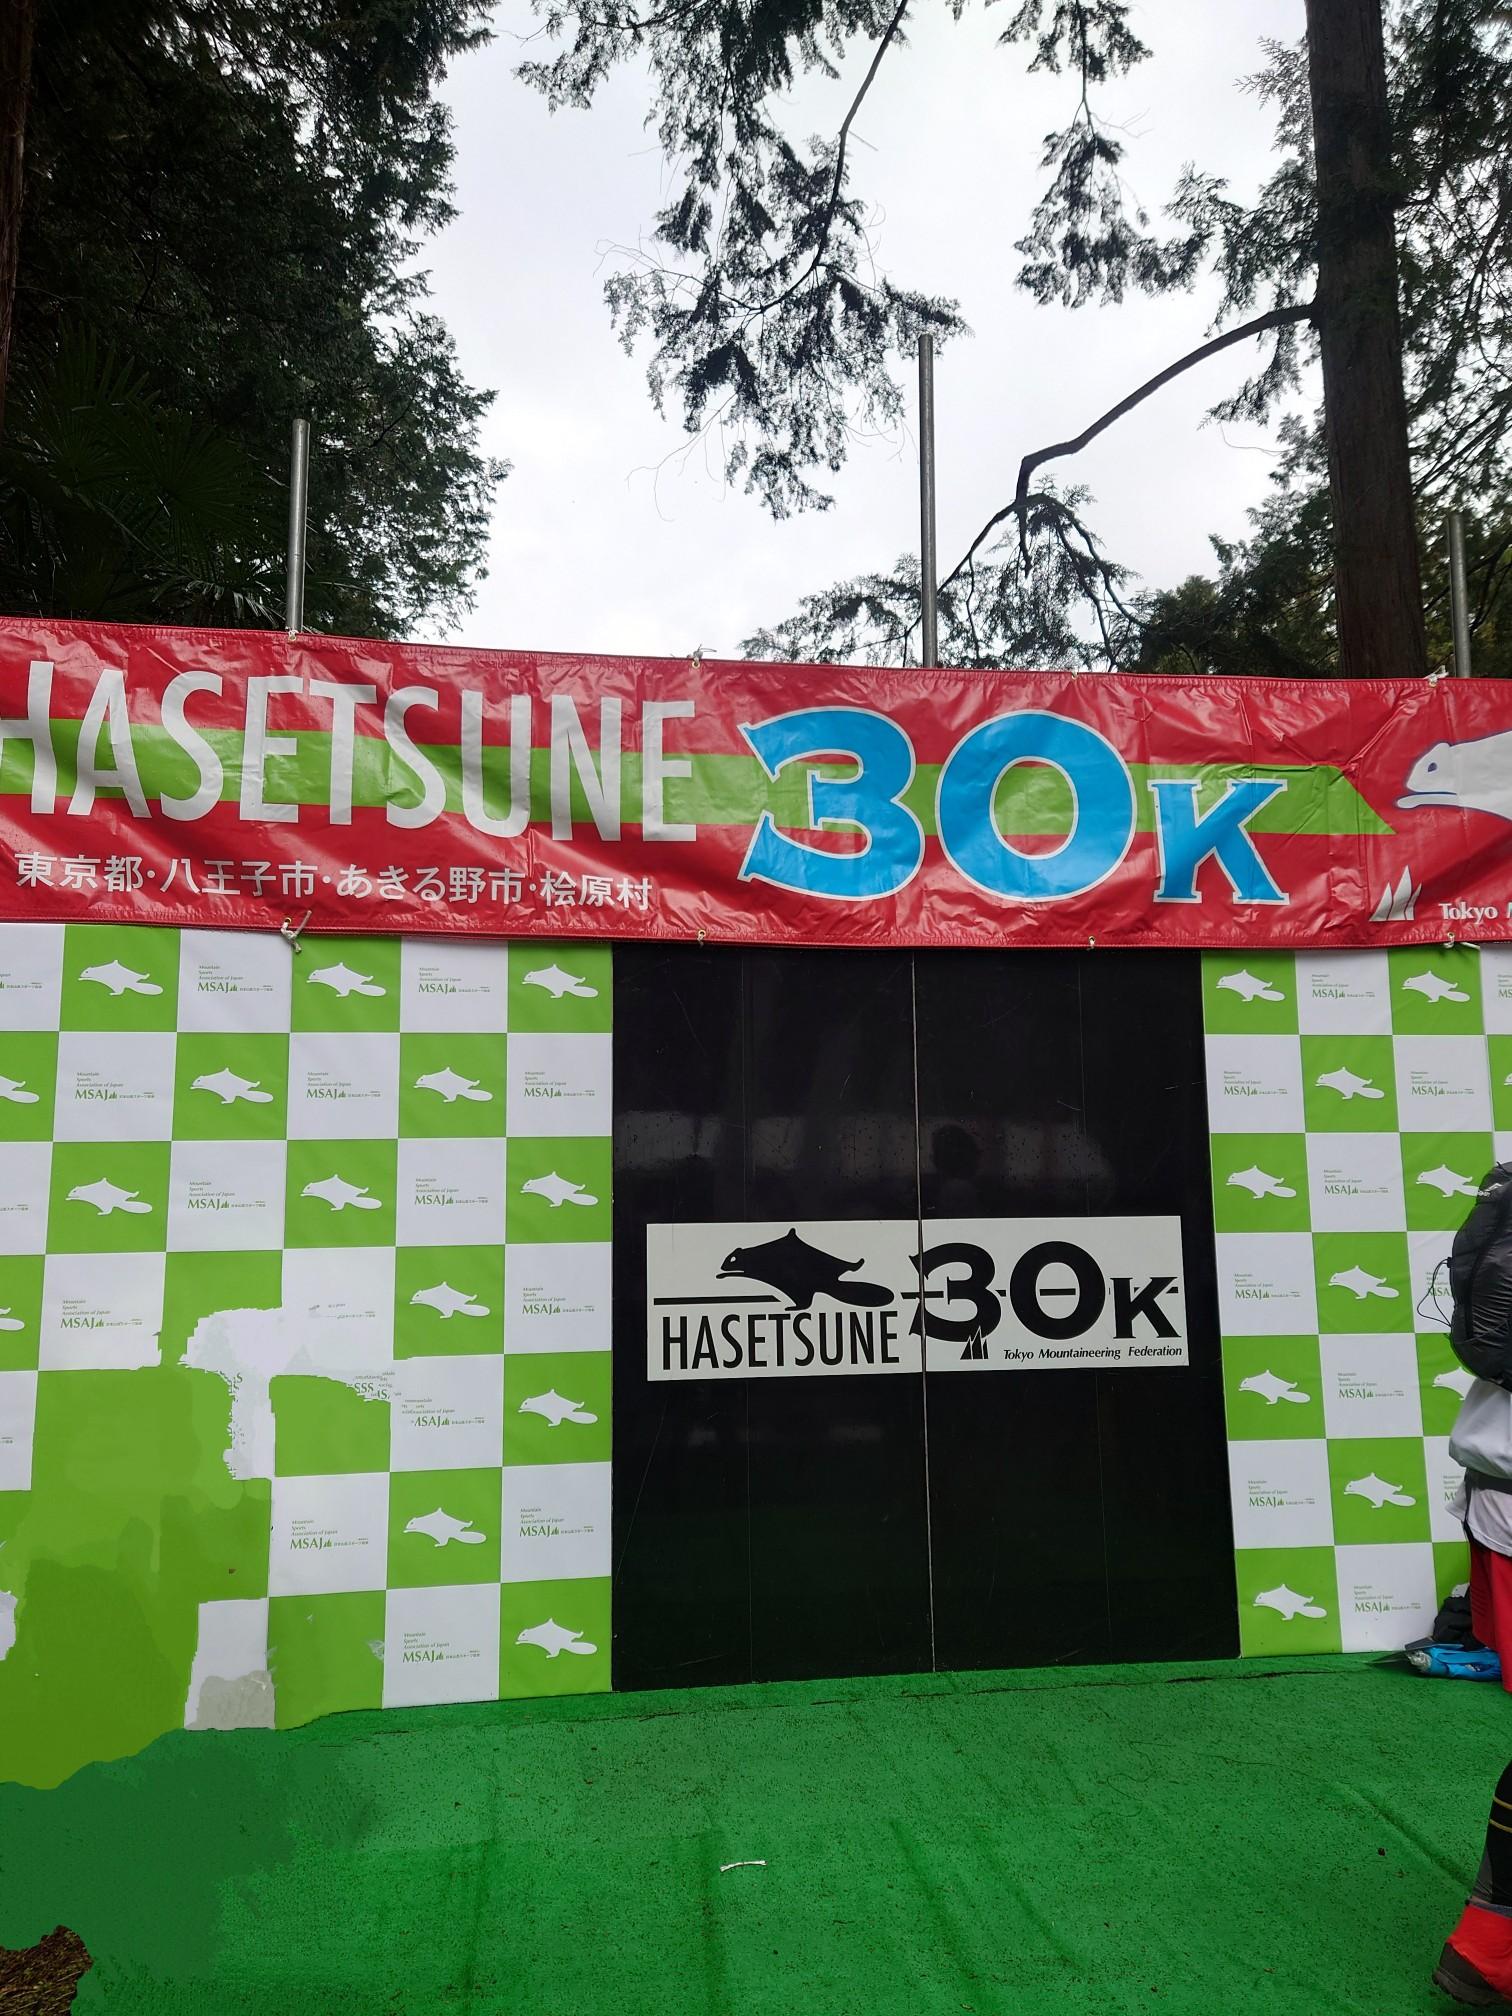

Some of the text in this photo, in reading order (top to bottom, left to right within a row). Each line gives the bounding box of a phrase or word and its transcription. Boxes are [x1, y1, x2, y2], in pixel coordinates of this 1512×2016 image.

[0, 661, 697, 842] HASETSUNE
[1438, 902, 1498, 924] Tokyo
[197, 982, 229, 993] MSAJ
[418, 983, 448, 994] MSAJ
[1311, 988, 1338, 999] MSAJ
[75, 1089, 108, 1101] MSAJ
[306, 1088, 337, 1100] MSAJ
[524, 1087, 554, 1098] MSAJ
[1223, 1086, 1251, 1096] MSAJ
[1411, 1086, 1438, 1096] MSAJ
[1324, 1185, 1351, 1195] MSAJ
[188, 1198, 220, 1210] MSAJ
[414, 1195, 445, 1206] MSAJ
[1234, 1289, 1262, 1300] MSAJ
[522, 1304, 552, 1315] MSAJ
[662, 1240, 1182, 1370] HASETSUNE 30K
[60, 1317, 94, 1330] MSAJ
[1004, 1344, 1182, 1362] Tokyo Mountaineering Federation
[1338, 1388, 1366, 1399] MSAJ
[1248, 1496, 1277, 1508] MSAJ
[519, 1525, 550, 1538] MSAJ
[290, 1537, 323, 1551] MSAJ
[1354, 1602, 1383, 1614] MSAJ
[402, 1650, 435, 1664] MSAJ
